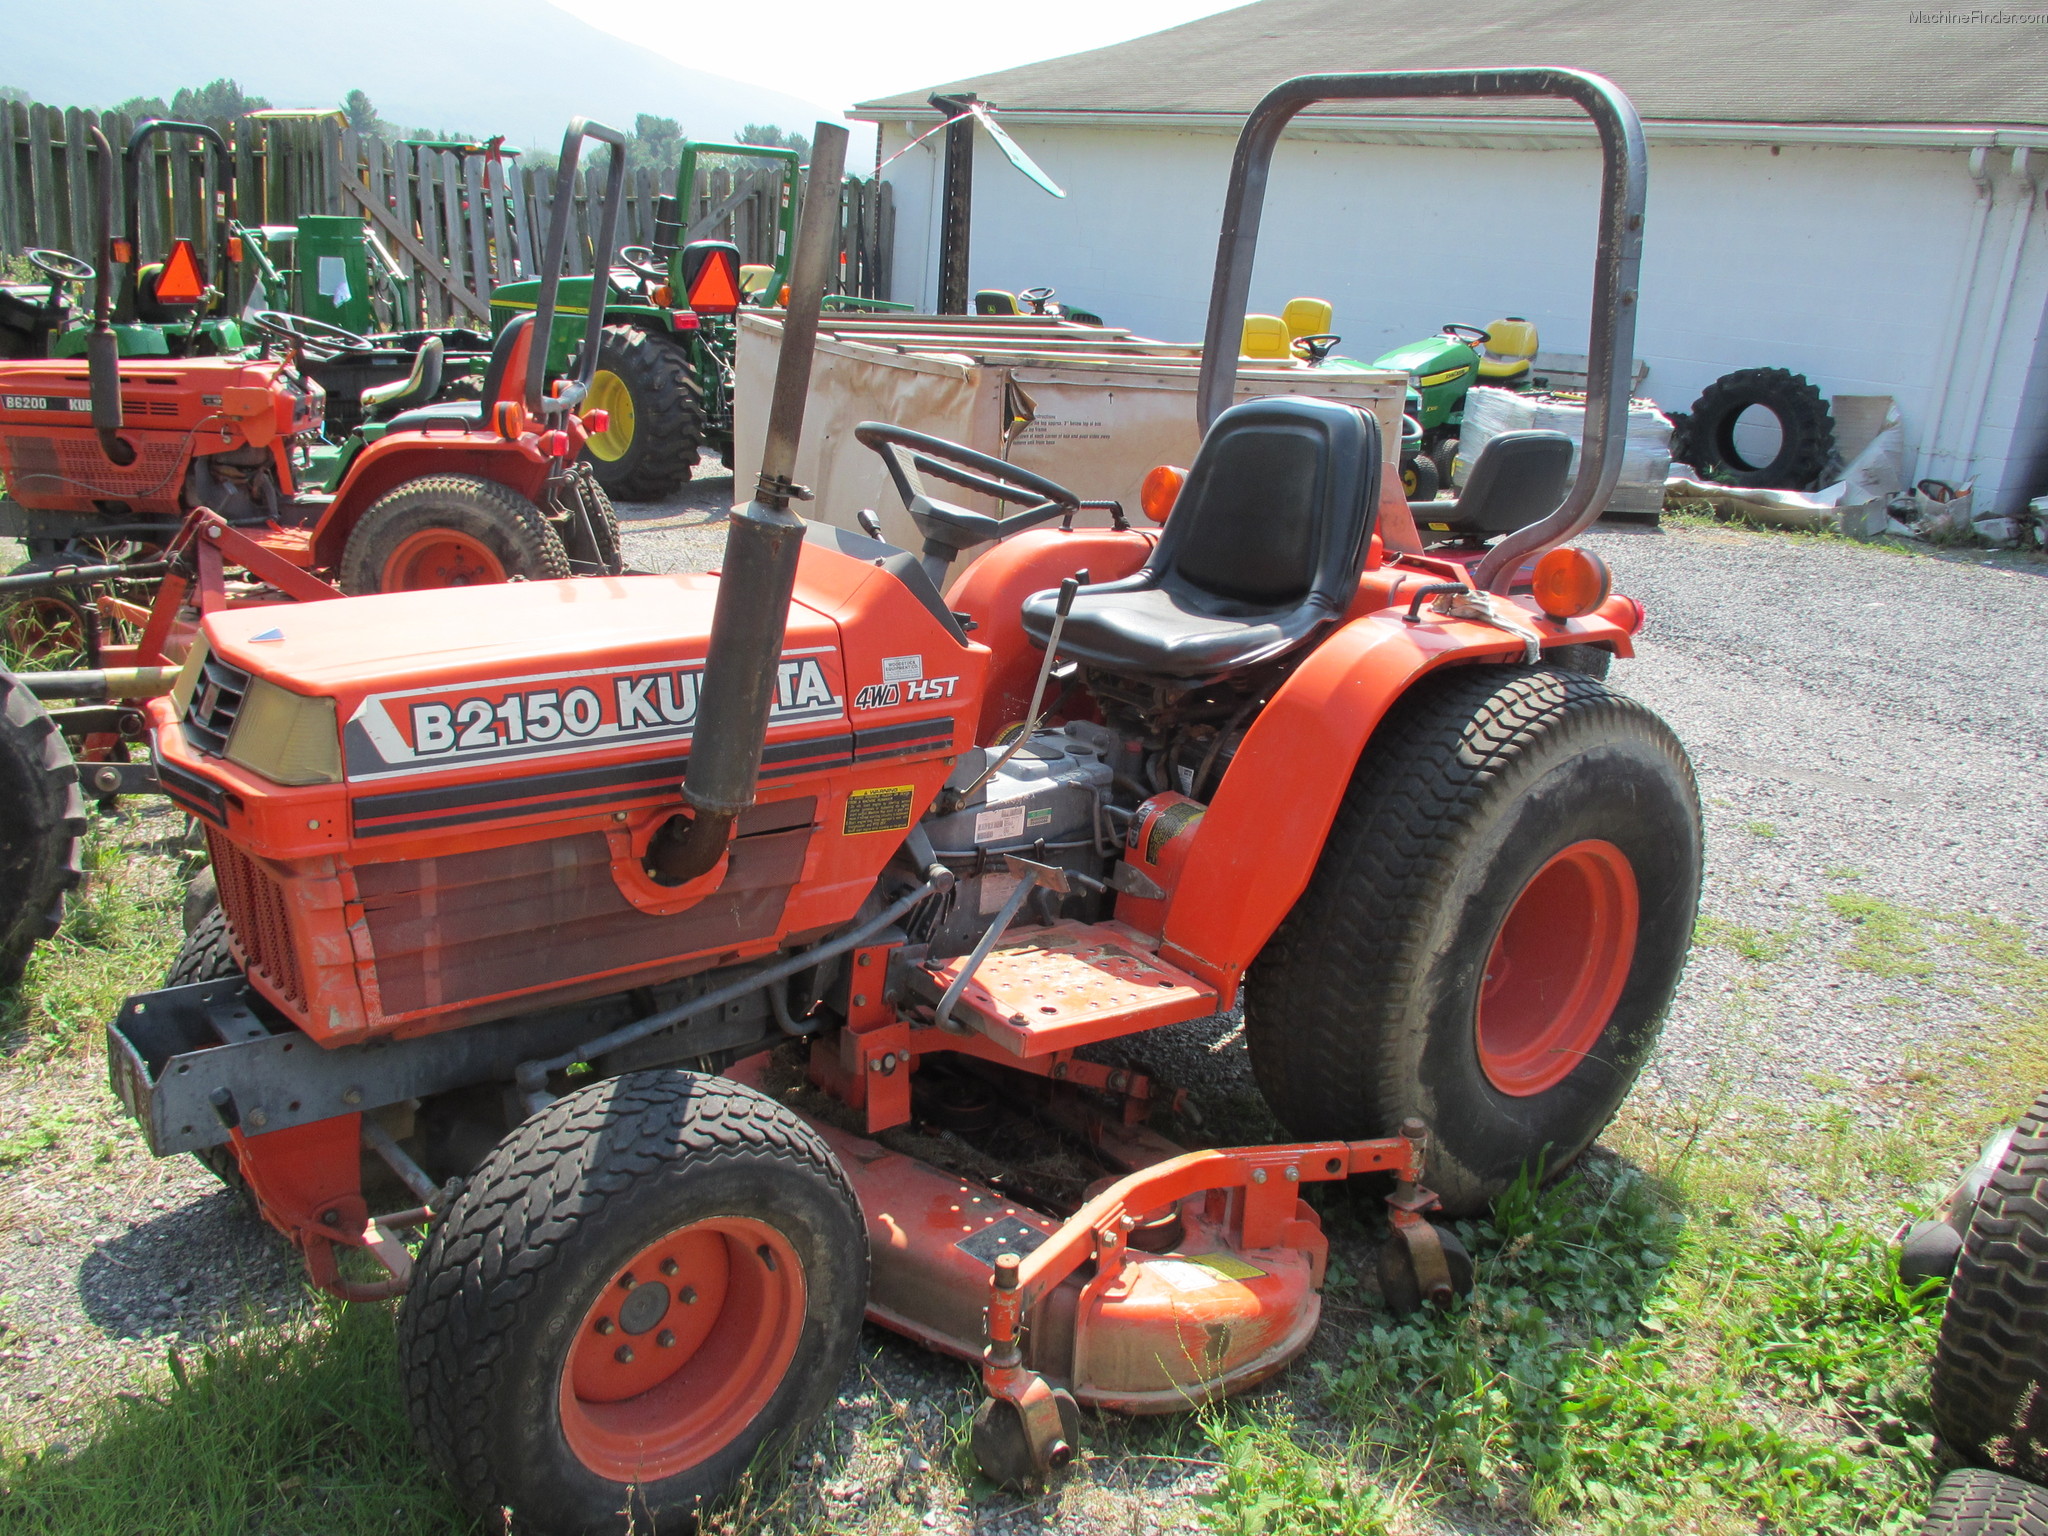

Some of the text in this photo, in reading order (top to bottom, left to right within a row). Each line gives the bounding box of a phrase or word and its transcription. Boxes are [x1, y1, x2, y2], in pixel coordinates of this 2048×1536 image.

[6, 396, 93, 412] B6200 KUB
[409, 657, 836, 756] B2150 KUTA
[854, 675, 960, 710] 4WD HST
